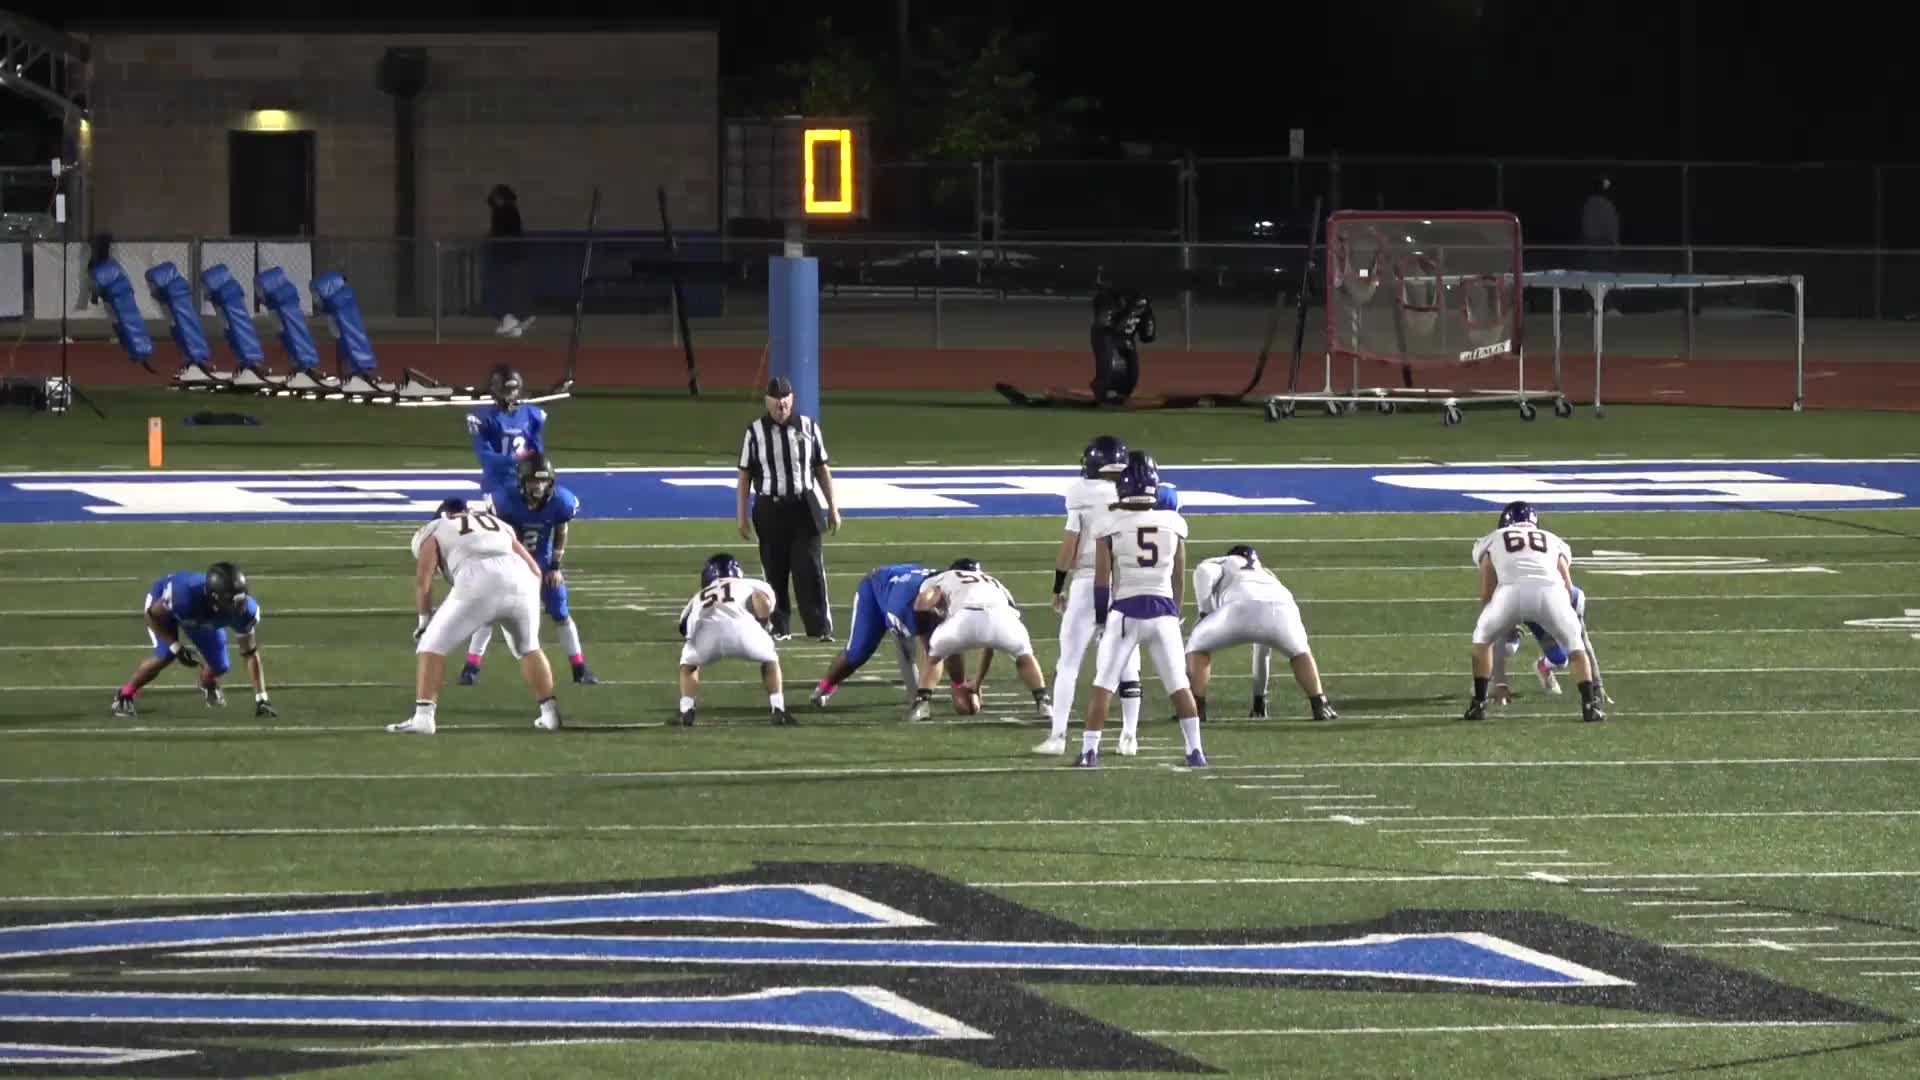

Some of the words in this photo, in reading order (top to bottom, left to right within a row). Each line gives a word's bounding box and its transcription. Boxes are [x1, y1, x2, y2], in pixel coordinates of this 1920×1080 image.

[804, 129, 853, 214] 0
[448, 512, 501, 536] 70
[1136, 526, 1159, 568] 5
[1503, 530, 1548, 553] 68
[700, 582, 735, 609] 51
